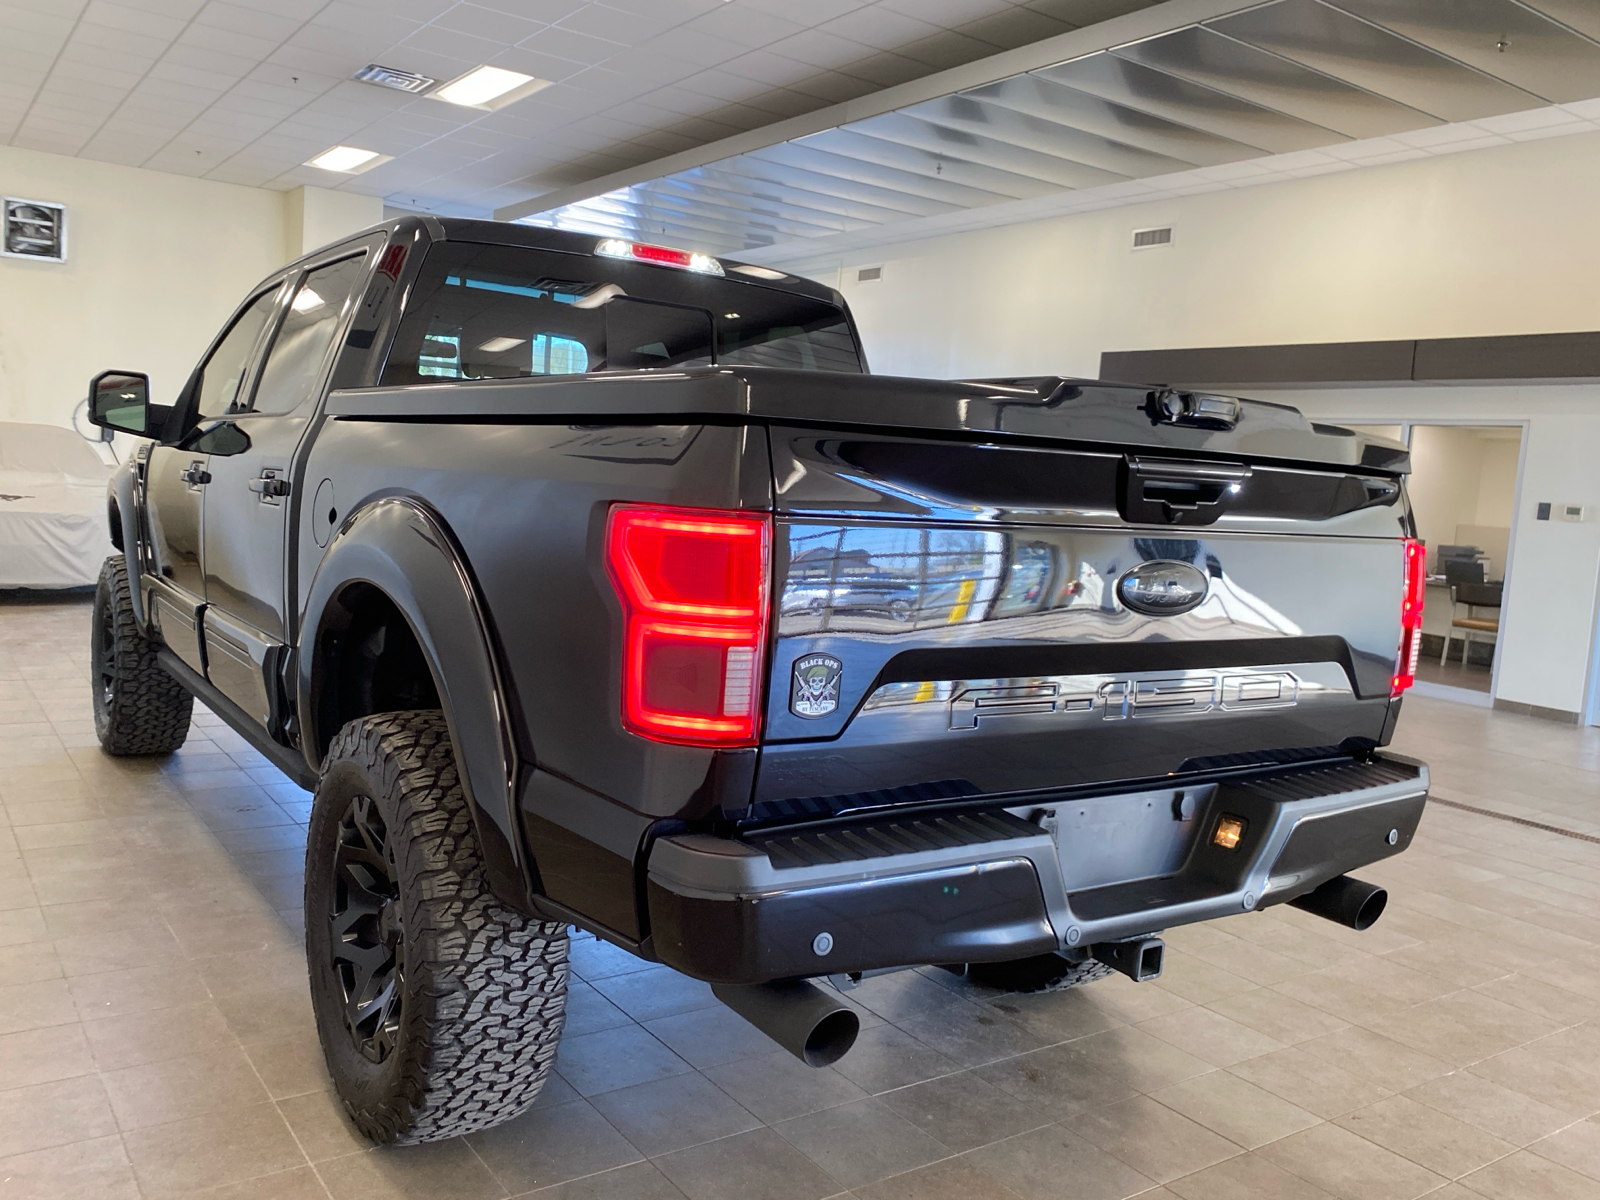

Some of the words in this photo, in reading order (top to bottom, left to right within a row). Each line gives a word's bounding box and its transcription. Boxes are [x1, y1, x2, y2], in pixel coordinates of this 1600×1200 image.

[800, 658, 824, 669] BLACK
[824, 659, 838, 669] OPS
[948, 671, 1298, 731] F-150
